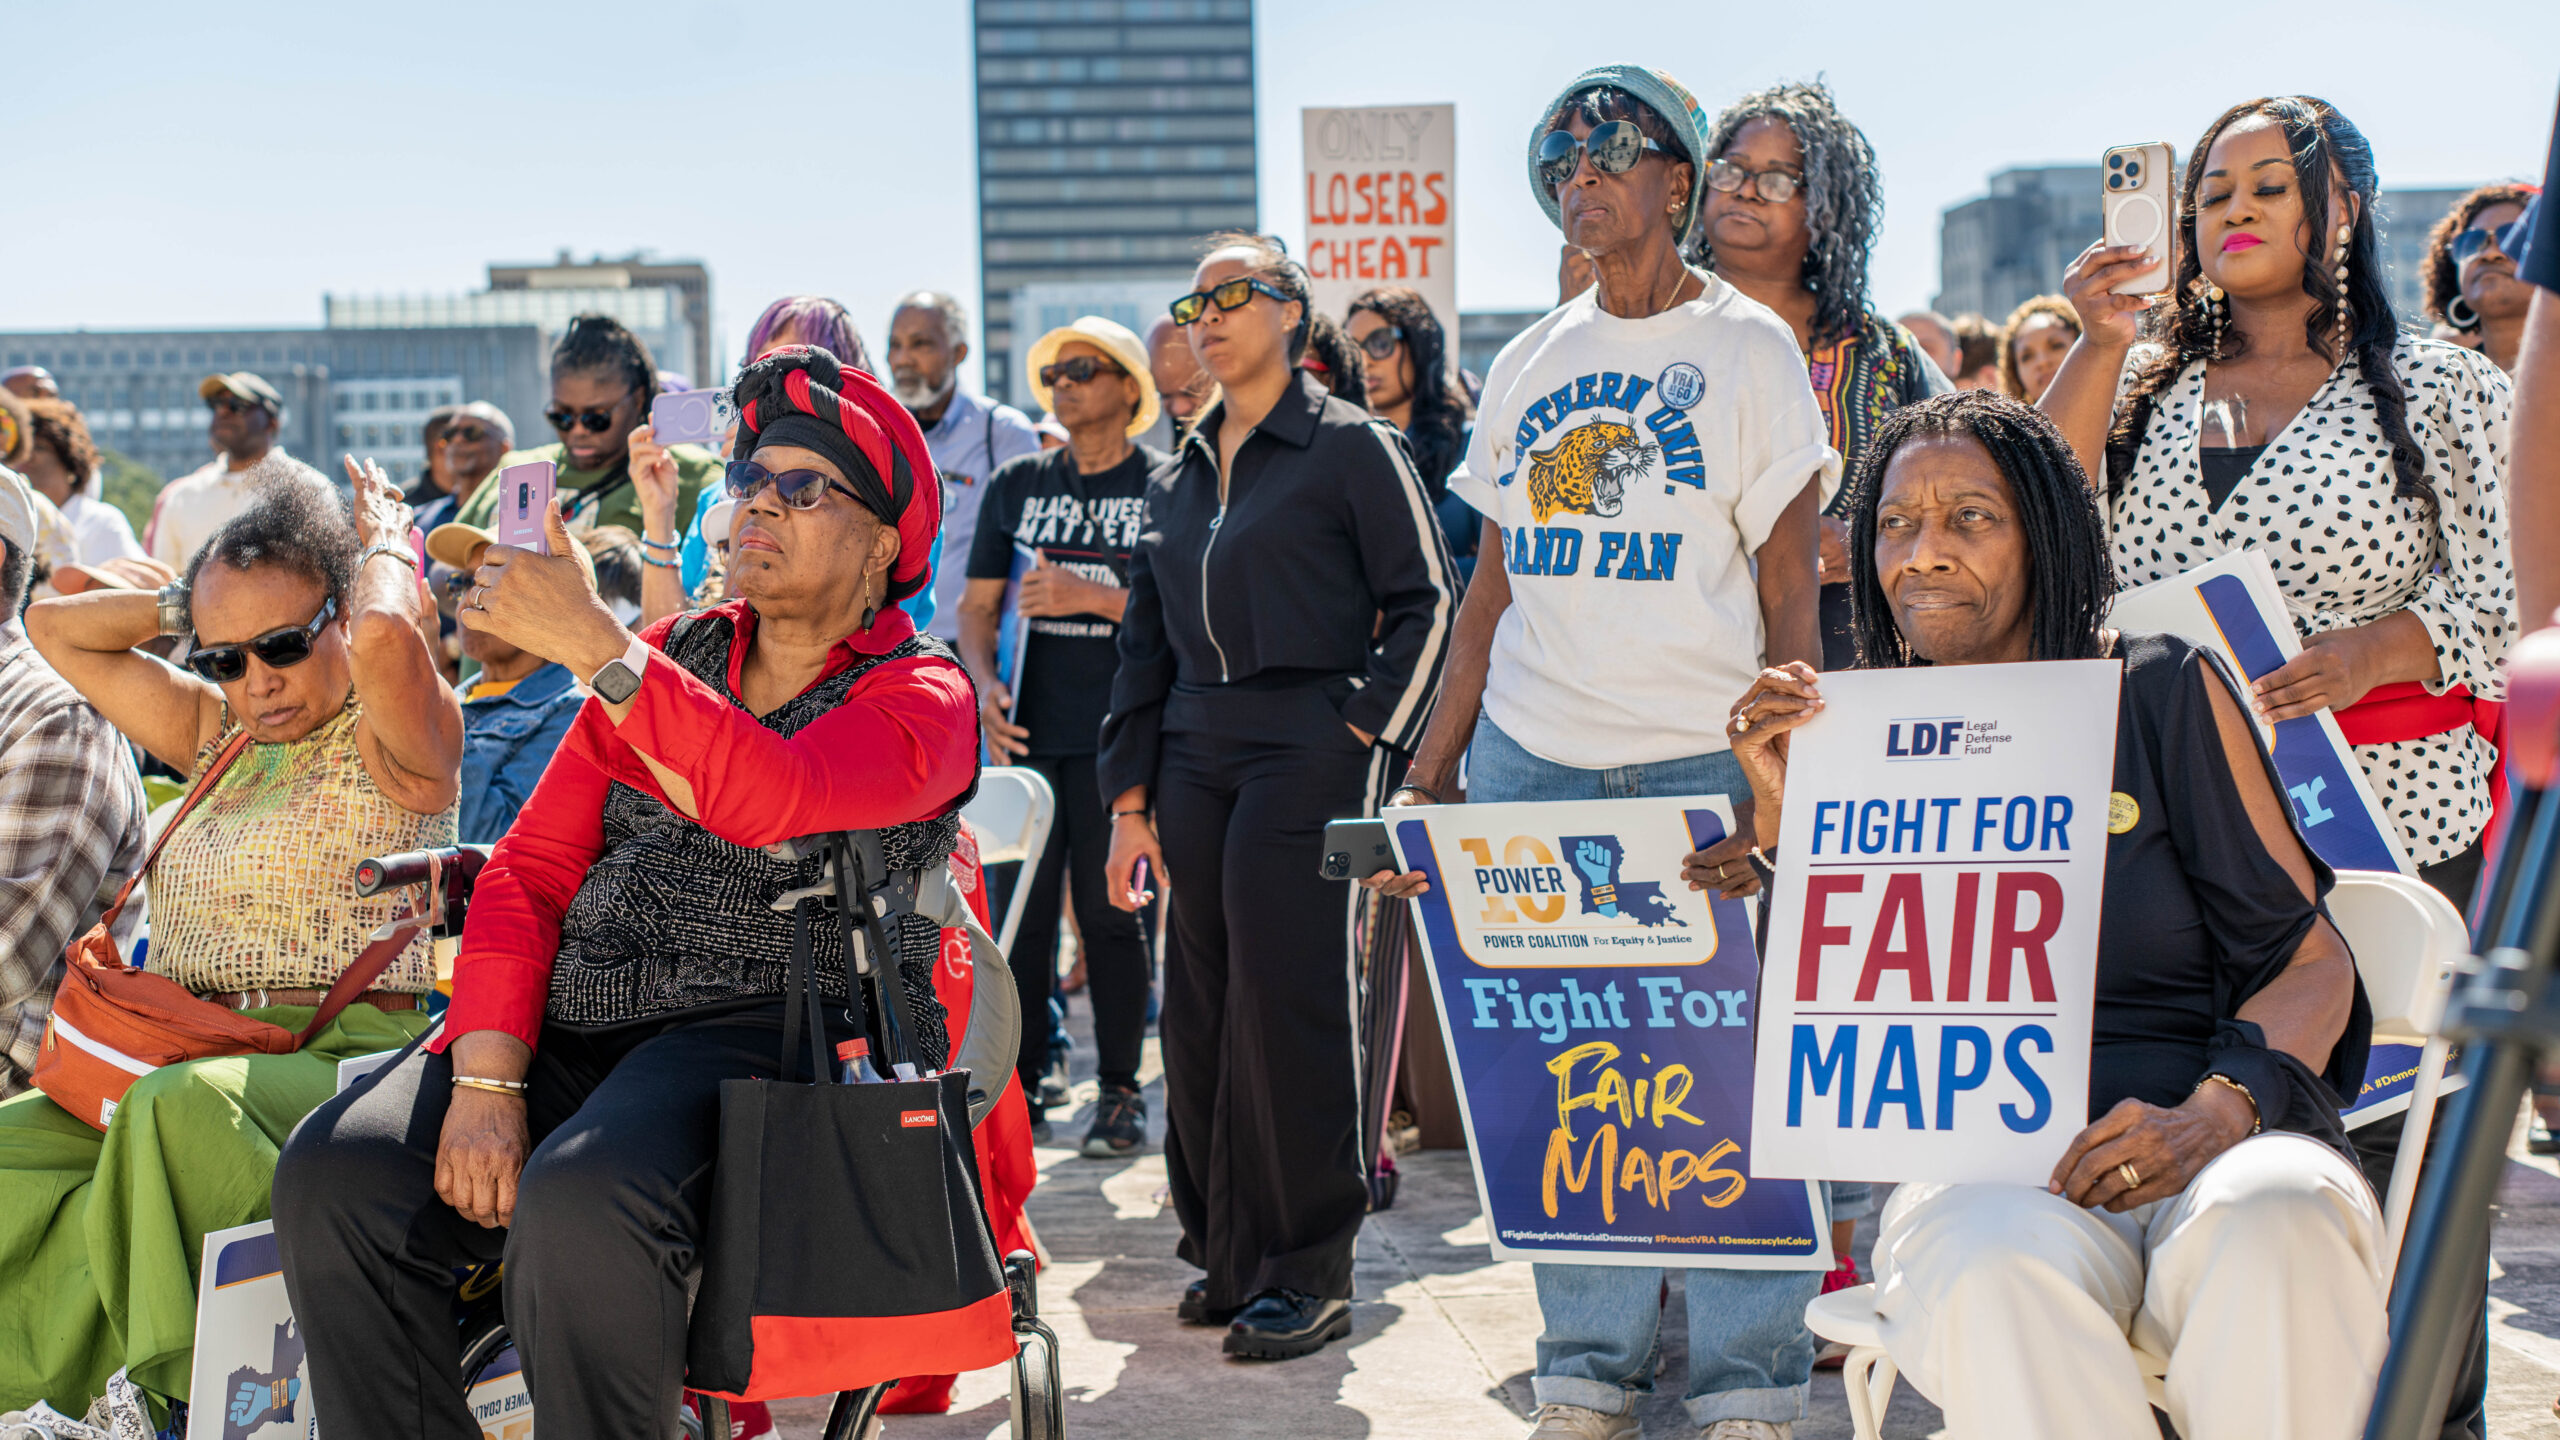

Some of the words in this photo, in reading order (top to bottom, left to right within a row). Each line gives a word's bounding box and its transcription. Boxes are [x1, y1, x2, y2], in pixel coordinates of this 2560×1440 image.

[1319, 111, 1433, 162] ONLY
[1307, 171, 1448, 226] LOSERS
[1307, 235, 1443, 280] CHEAT
[1672, 370, 1694, 389] VRA
[1676, 387, 1692, 400] 60
[1021, 494, 1084, 522] BLACK
[1088, 497, 1145, 524] LIVES
[1014, 518, 1141, 548] MATTER
[1594, 532, 1683, 581] FAN
[1886, 721, 1965, 757] LDF
[1965, 732, 2012, 744] Defense
[1966, 719, 1998, 733] Legal
[1964, 744, 1992, 755] Fund
[1811, 797, 1961, 855] FIGHT
[1972, 795, 2074, 852] FOR
[1474, 865, 1567, 895] POWER
[1483, 934, 1525, 948] POWER
[1529, 934, 1590, 948] COALITION
[1594, 936, 1609, 945] For
[1612, 935, 1645, 947] Equity
[1647, 937, 1655, 945] &
[1657, 934, 1693, 946] Justice
[1795, 871, 2065, 1002] FAIR
[1463, 977, 1631, 1044] Fight
[1638, 976, 1748, 1029] For
[1785, 1023, 2055, 1135] MAPS
[1655, 1235, 1718, 1245] #ProtectVRA
